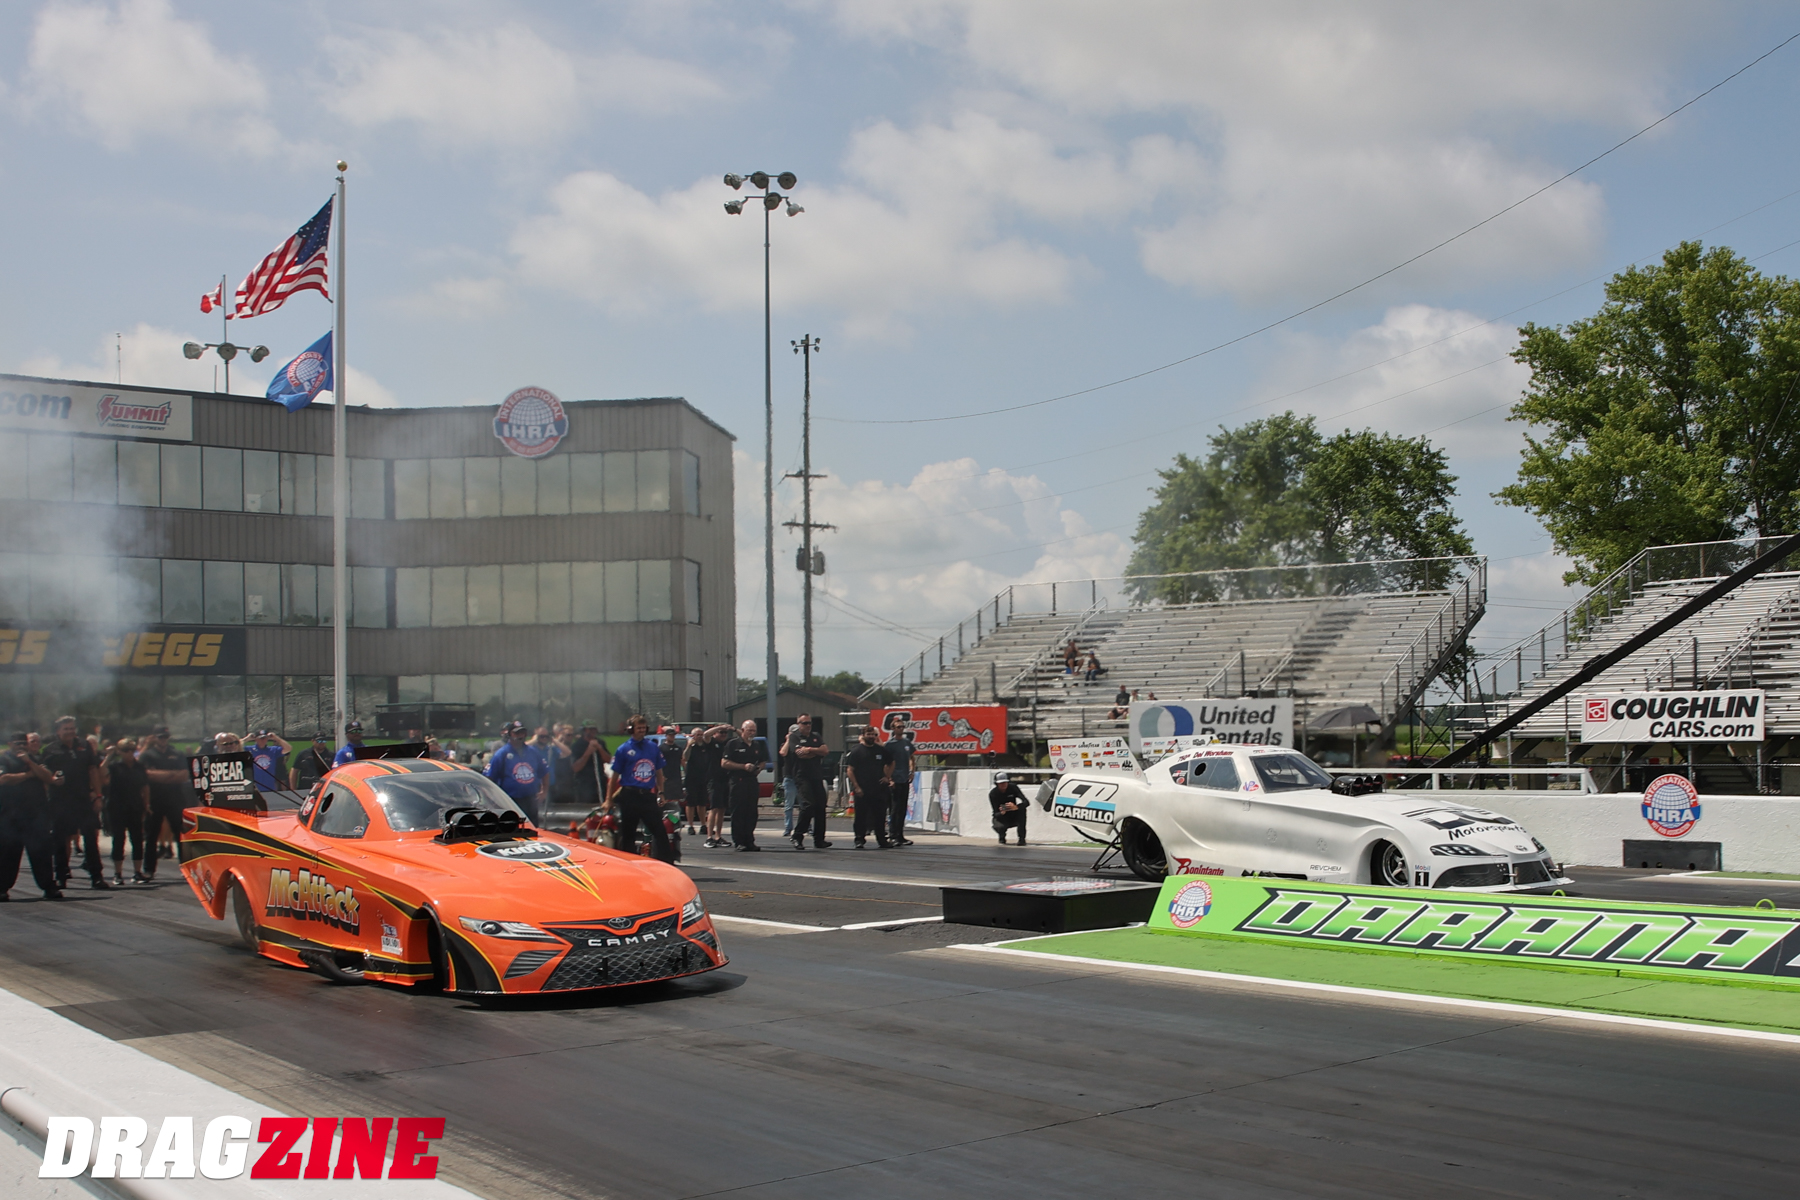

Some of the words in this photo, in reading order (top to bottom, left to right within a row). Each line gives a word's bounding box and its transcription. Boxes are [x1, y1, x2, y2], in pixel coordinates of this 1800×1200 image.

[499, 389, 563, 420] INTERNATIONAL
[502, 422, 559, 439] IHRA
[102, 632, 224, 668] JEGS
[1200, 704, 1277, 725] United
[1611, 696, 1760, 720] COUGHLIN
[1649, 720, 1755, 739] CARS.com
[210, 761, 244, 782] SPEAR
[1645, 776, 1696, 804] INTERNATIONAL
[1055, 805, 1114, 824] CARRILLO
[1647, 806, 1696, 822] IHRA
[1448, 825, 1527, 841] Motorsports
[1309, 864, 1342, 872] REVCHEM
[1414, 864, 1431, 872] Mobil
[266, 867, 360, 932] McAttack
[1171, 903, 1205, 917] IHRA
